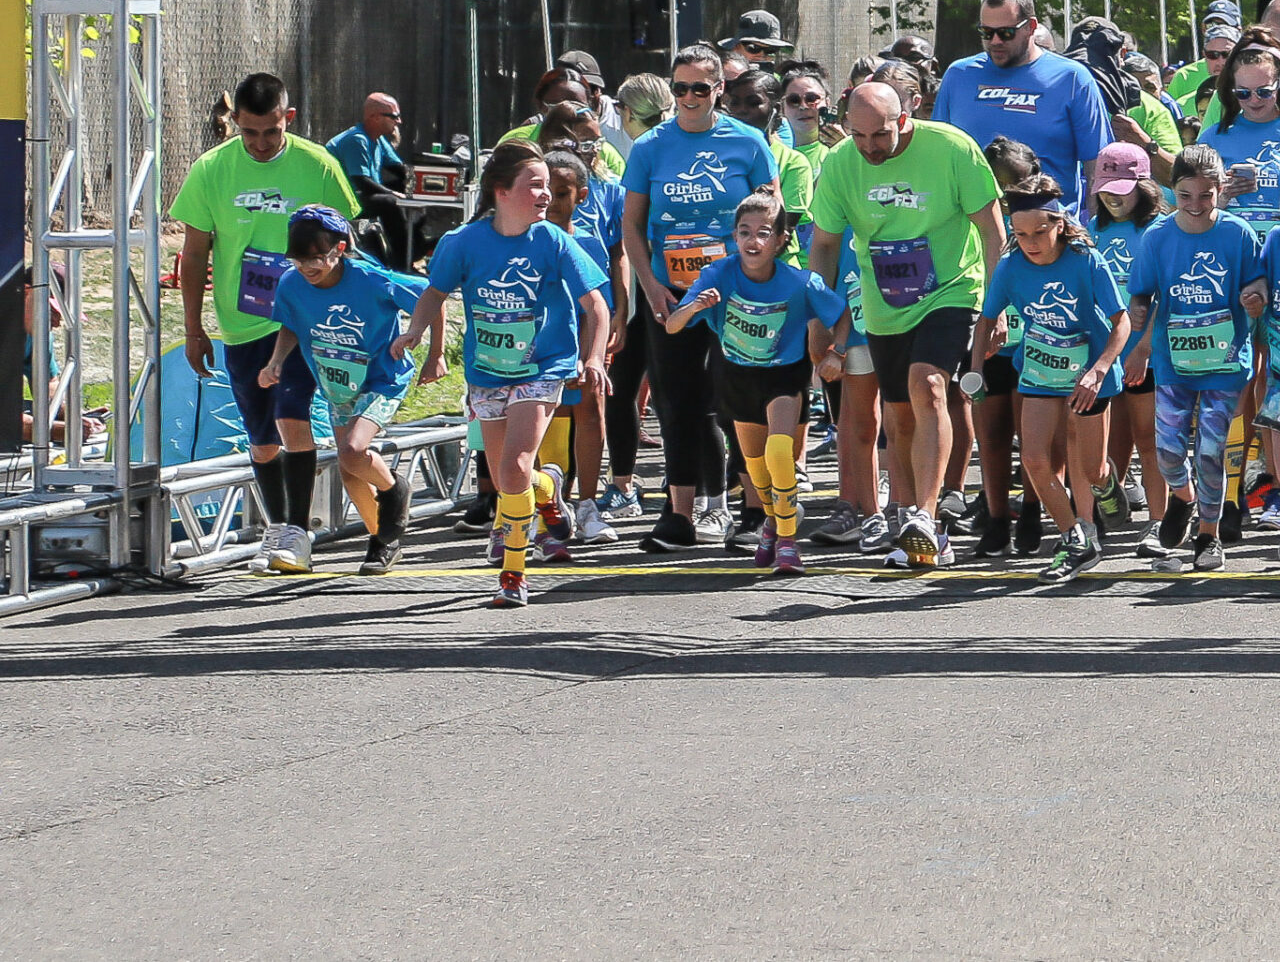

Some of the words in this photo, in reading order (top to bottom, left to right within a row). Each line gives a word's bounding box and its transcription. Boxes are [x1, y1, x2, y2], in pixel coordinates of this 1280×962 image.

[663, 181, 701, 196] Girls
[683, 189, 714, 204] run
[477, 286, 515, 302] Girls
[1169, 283, 1203, 297] Girls
[497, 300, 526, 309] run
[1186, 294, 1214, 305] run
[726, 310, 767, 338] 22860
[1170, 334, 1216, 351] 22861
[1025, 345, 1071, 370] 22859
